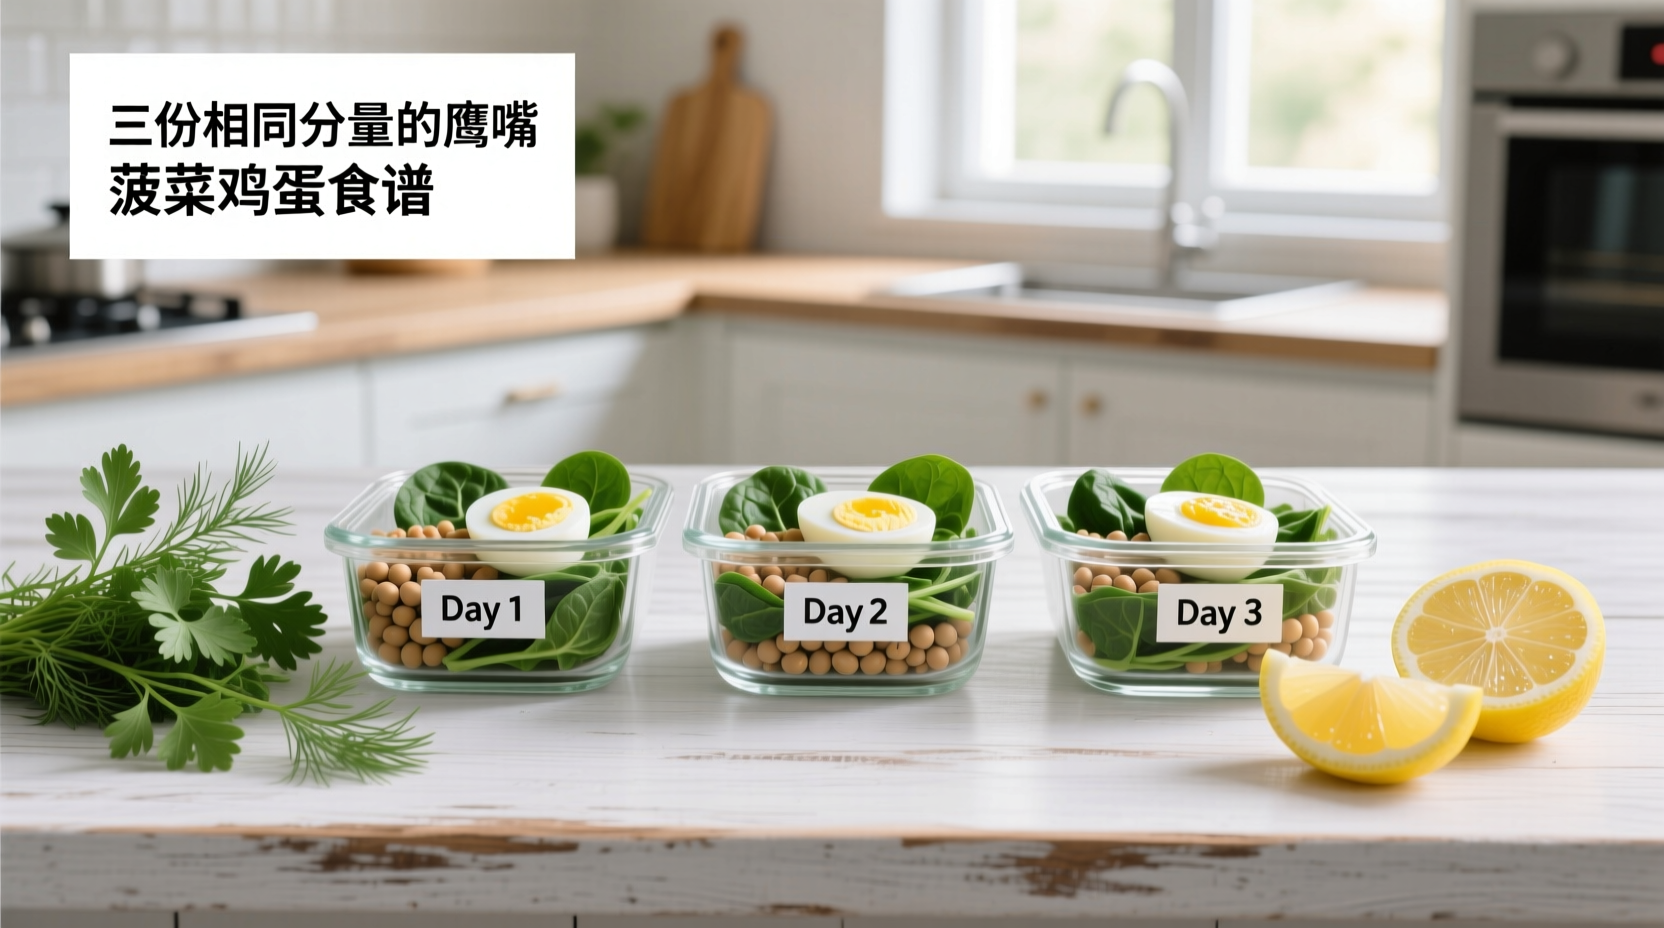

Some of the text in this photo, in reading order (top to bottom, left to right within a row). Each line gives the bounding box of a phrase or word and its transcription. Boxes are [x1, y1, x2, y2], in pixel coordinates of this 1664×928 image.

[441, 594, 521, 631] Day 1
[804, 597, 888, 634] Day 2
[1177, 598, 1263, 635] Day 3
